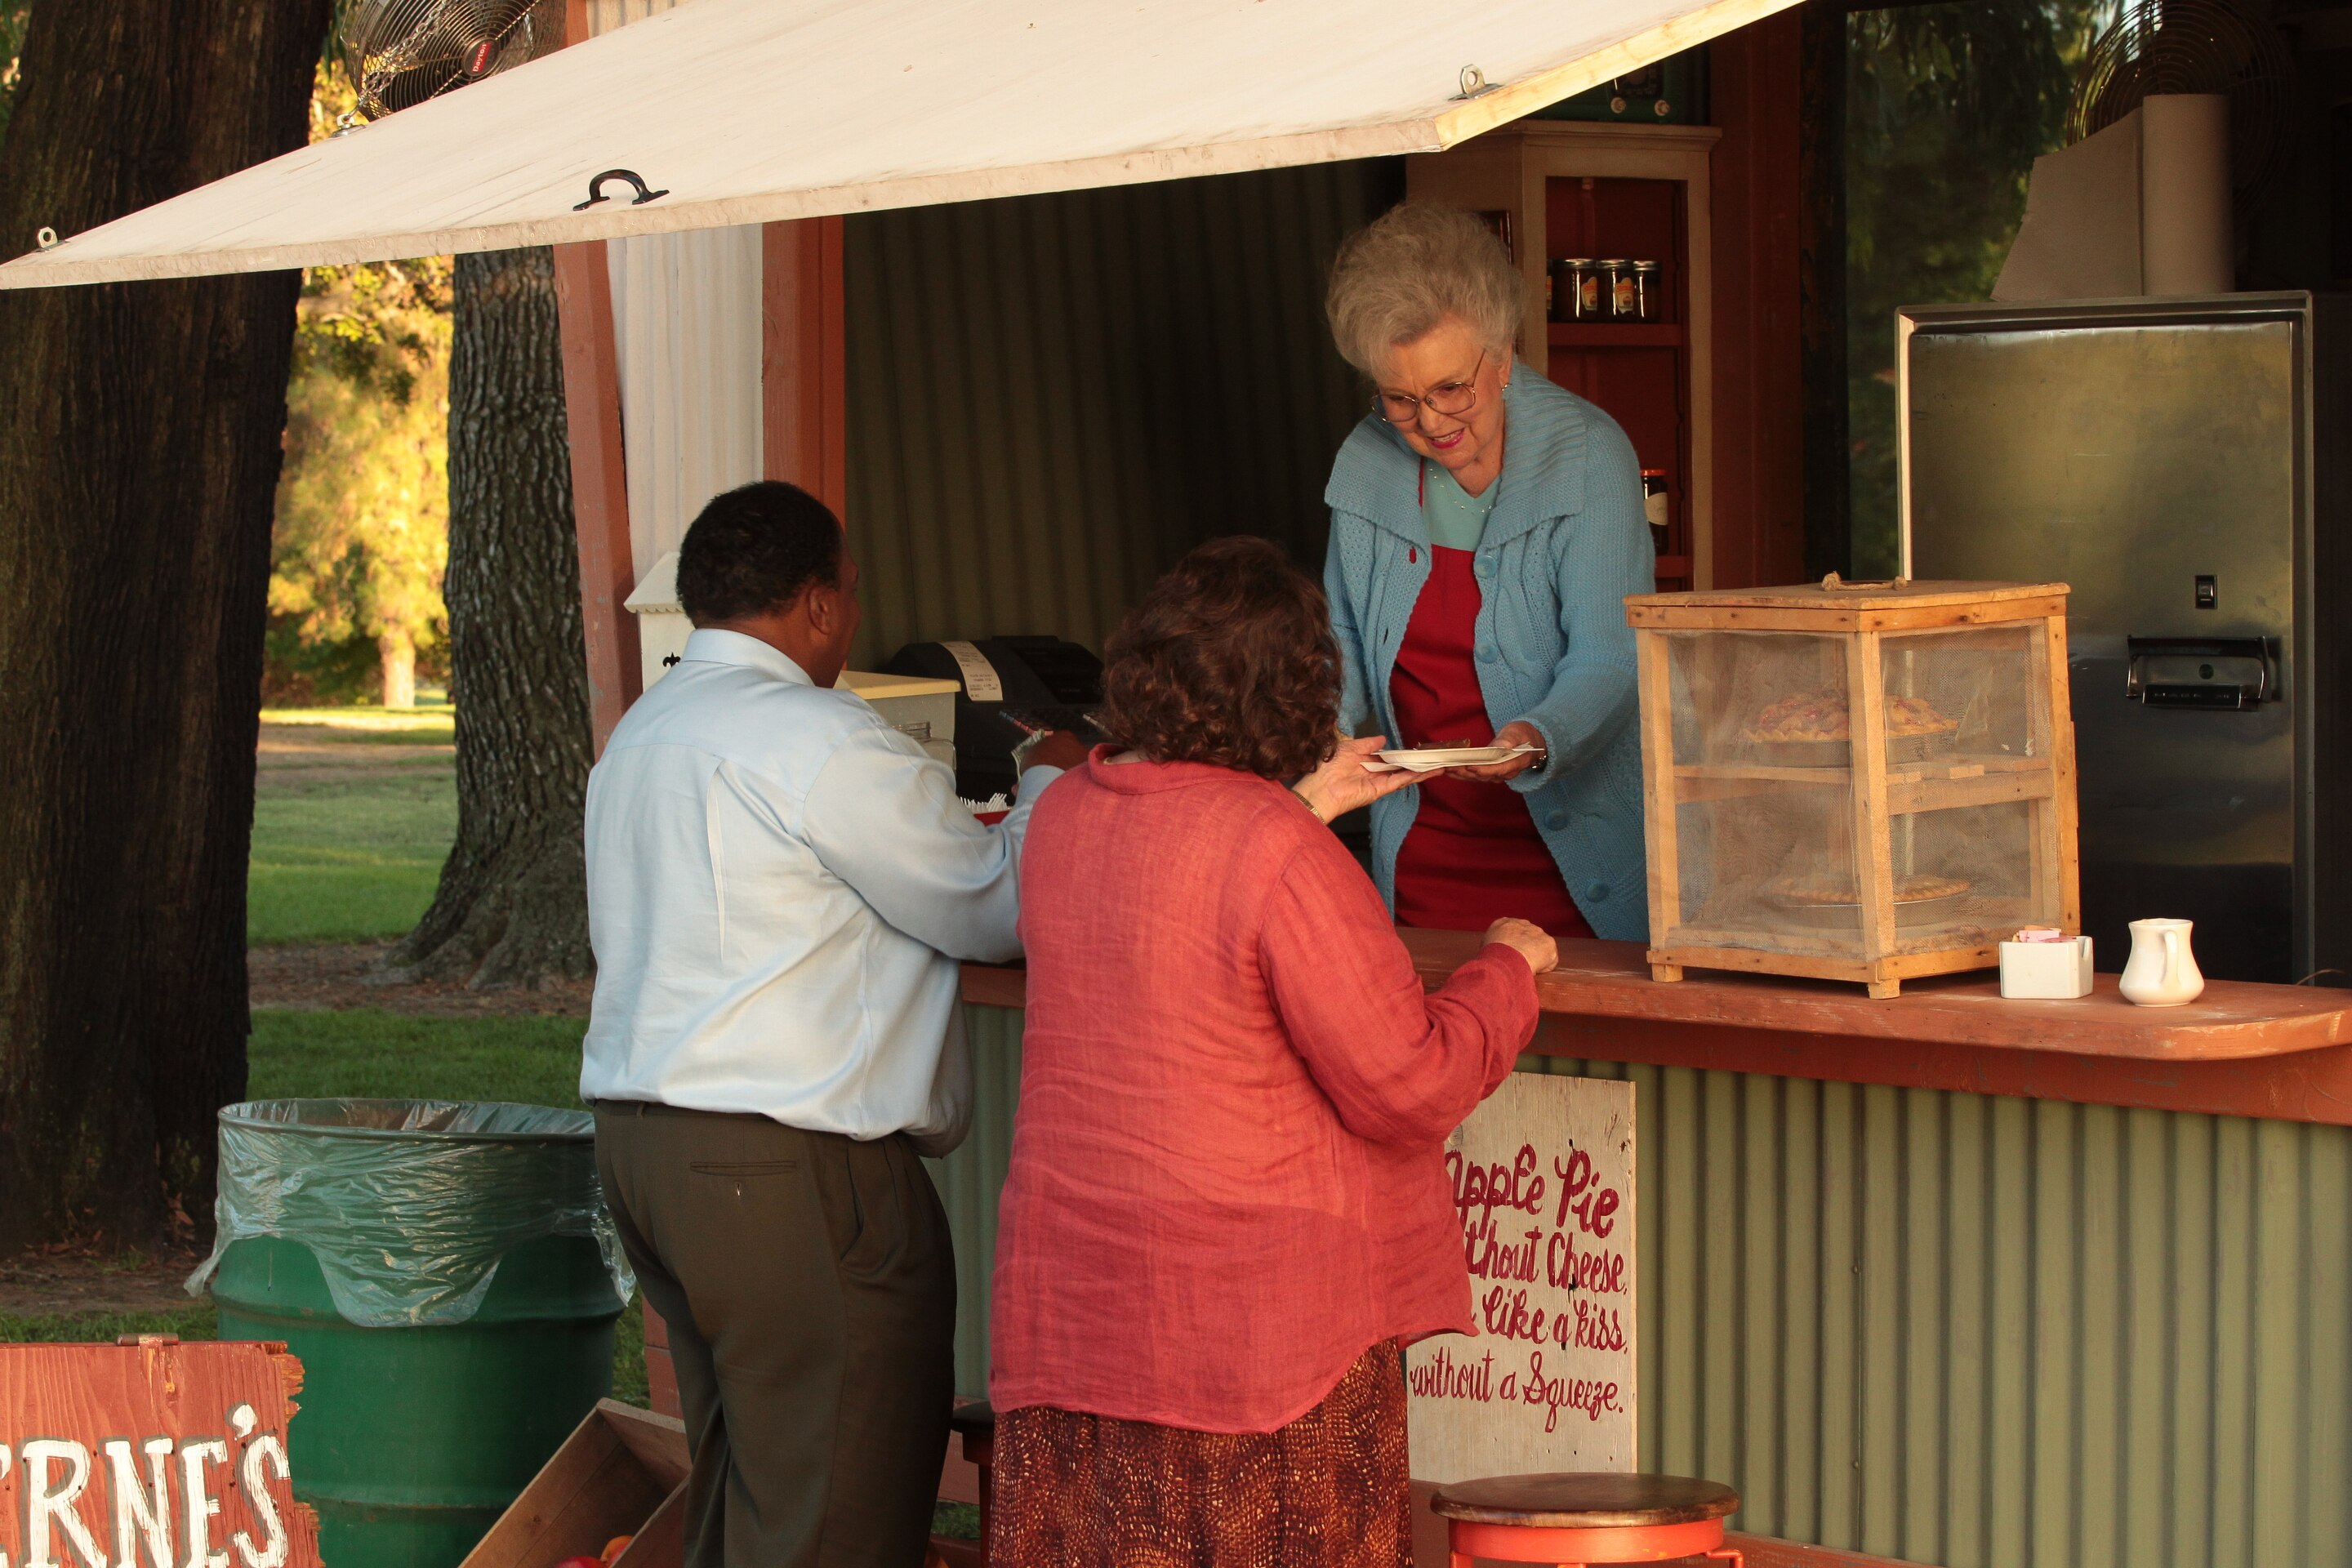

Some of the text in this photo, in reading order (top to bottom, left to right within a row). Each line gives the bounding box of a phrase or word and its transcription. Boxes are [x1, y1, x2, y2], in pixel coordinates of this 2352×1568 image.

[473, 42, 487, 72] Dayton
[1555, 1148, 1620, 1238] Pie
[1465, 1219, 1628, 1295] thout Cheese,
[1482, 1285, 1548, 1344] like
[1552, 1312, 1573, 1344] a
[1410, 1347, 1624, 1432] without a Squeeze.
